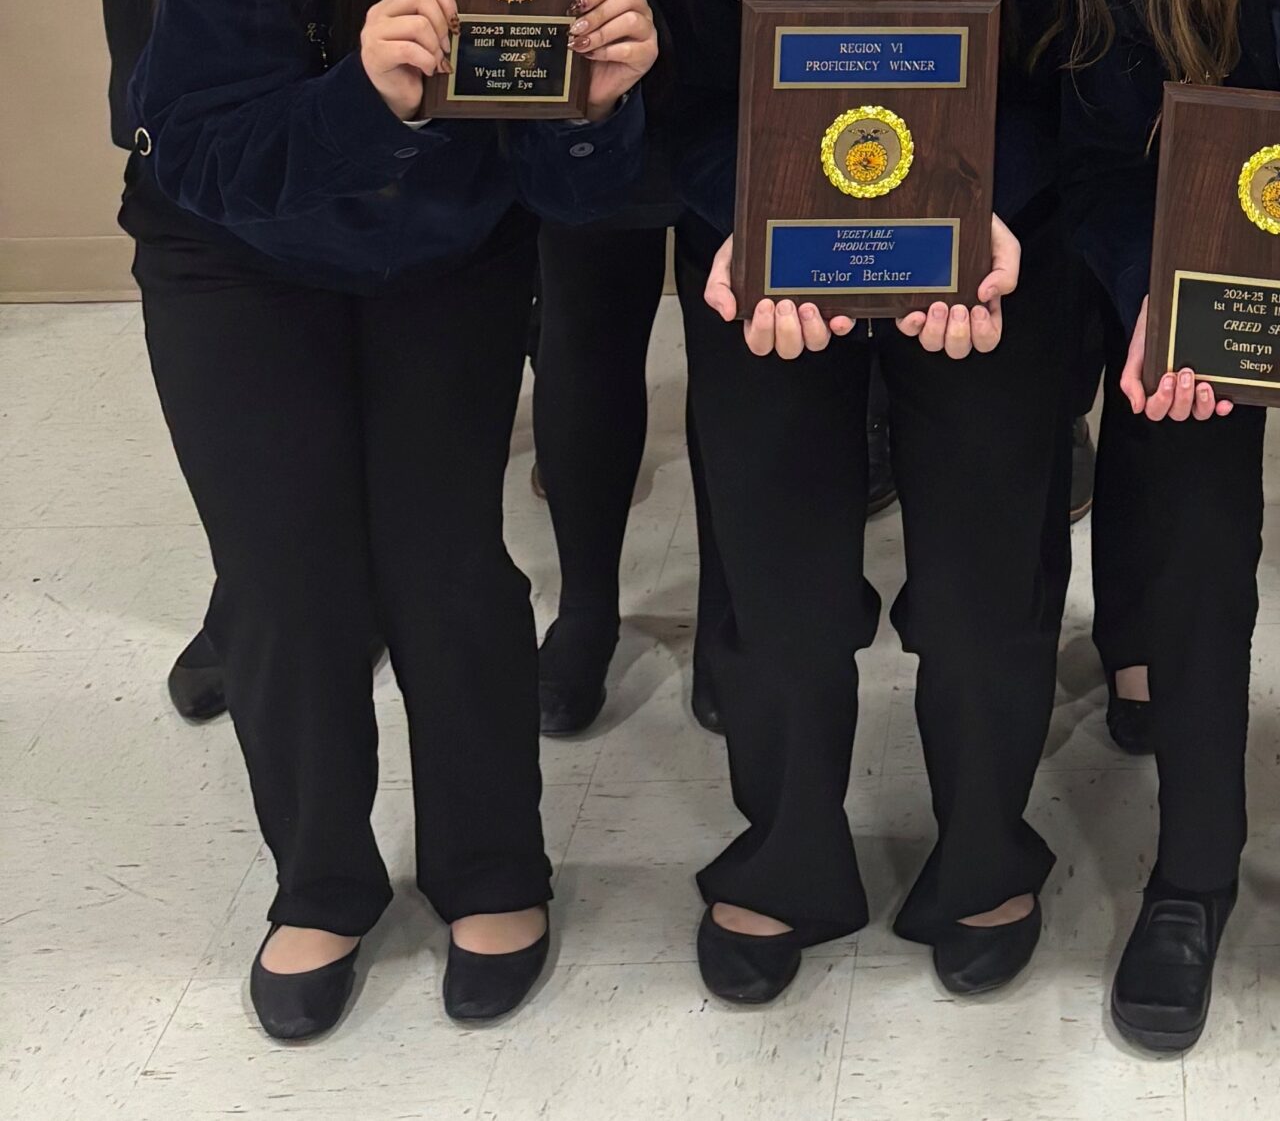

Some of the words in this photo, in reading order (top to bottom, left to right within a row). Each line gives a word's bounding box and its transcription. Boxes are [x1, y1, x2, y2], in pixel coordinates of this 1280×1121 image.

[470, 26, 504, 34] 2024-25
[510, 27, 541, 35] REGION
[501, 39, 551, 47] INDIVIDUAL
[840, 43, 881, 53] REGION
[891, 43, 903, 53] VI
[499, 53, 527, 61] SOILS
[806, 61, 880, 71] PROFICIENCY
[890, 61, 935, 70] WINNER
[474, 67, 505, 78] Wyatt
[514, 68, 546, 78] Feucht
[487, 80, 512, 89] Sleepy
[518, 81, 533, 89] Eye
[837, 230, 893, 238] VEGETABLE
[833, 242, 896, 251] PRODUCTION
[850, 255, 874, 264] 2025
[811, 270, 852, 284] Taylor
[863, 270, 912, 281] Berkner
[1224, 289, 1264, 302] 2024-25
[1233, 302, 1267, 315] PLACE
[1223, 320, 1262, 332] CREED
[1224, 339, 1272, 355] Camryn
[1240, 359, 1273, 373] Sleepy
